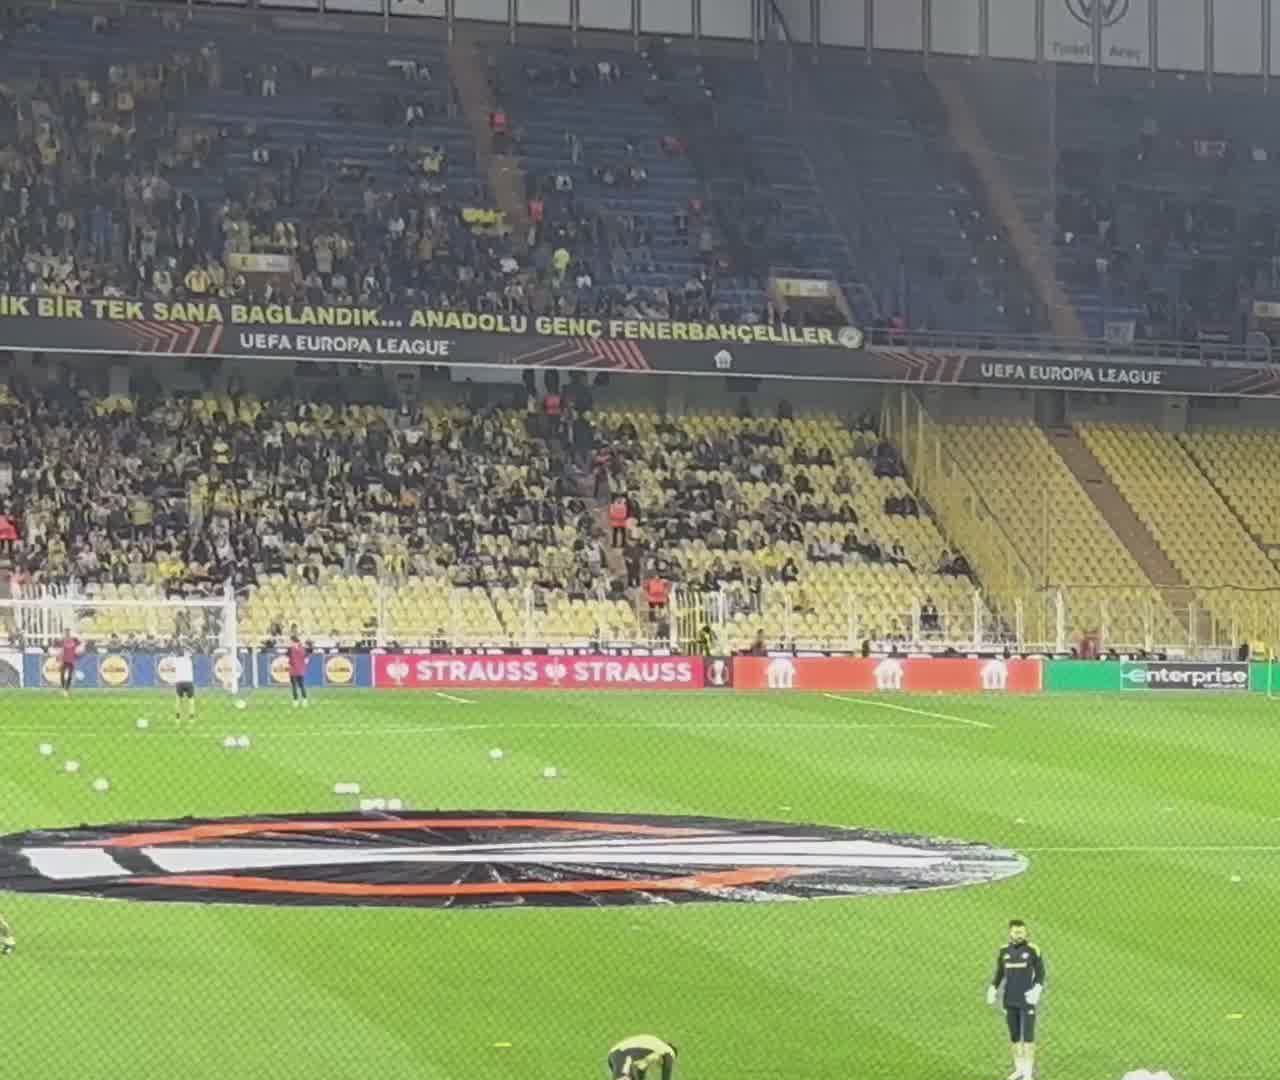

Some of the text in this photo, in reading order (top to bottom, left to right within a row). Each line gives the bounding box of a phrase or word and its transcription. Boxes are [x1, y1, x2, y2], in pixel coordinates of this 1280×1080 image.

[92, 299, 144, 320] TEK
[152, 302, 223, 323] SANA
[411, 309, 527, 333] ANADOLU
[240, 333, 450, 356] UEFA EUROPA LEAGUE
[980, 363, 1161, 385] UEFA EUROPA LEAGUE
[416, 661, 539, 682] STRAUSS
[574, 662, 692, 683] STRAUSS
[1124, 666, 1248, 688] enterprise
